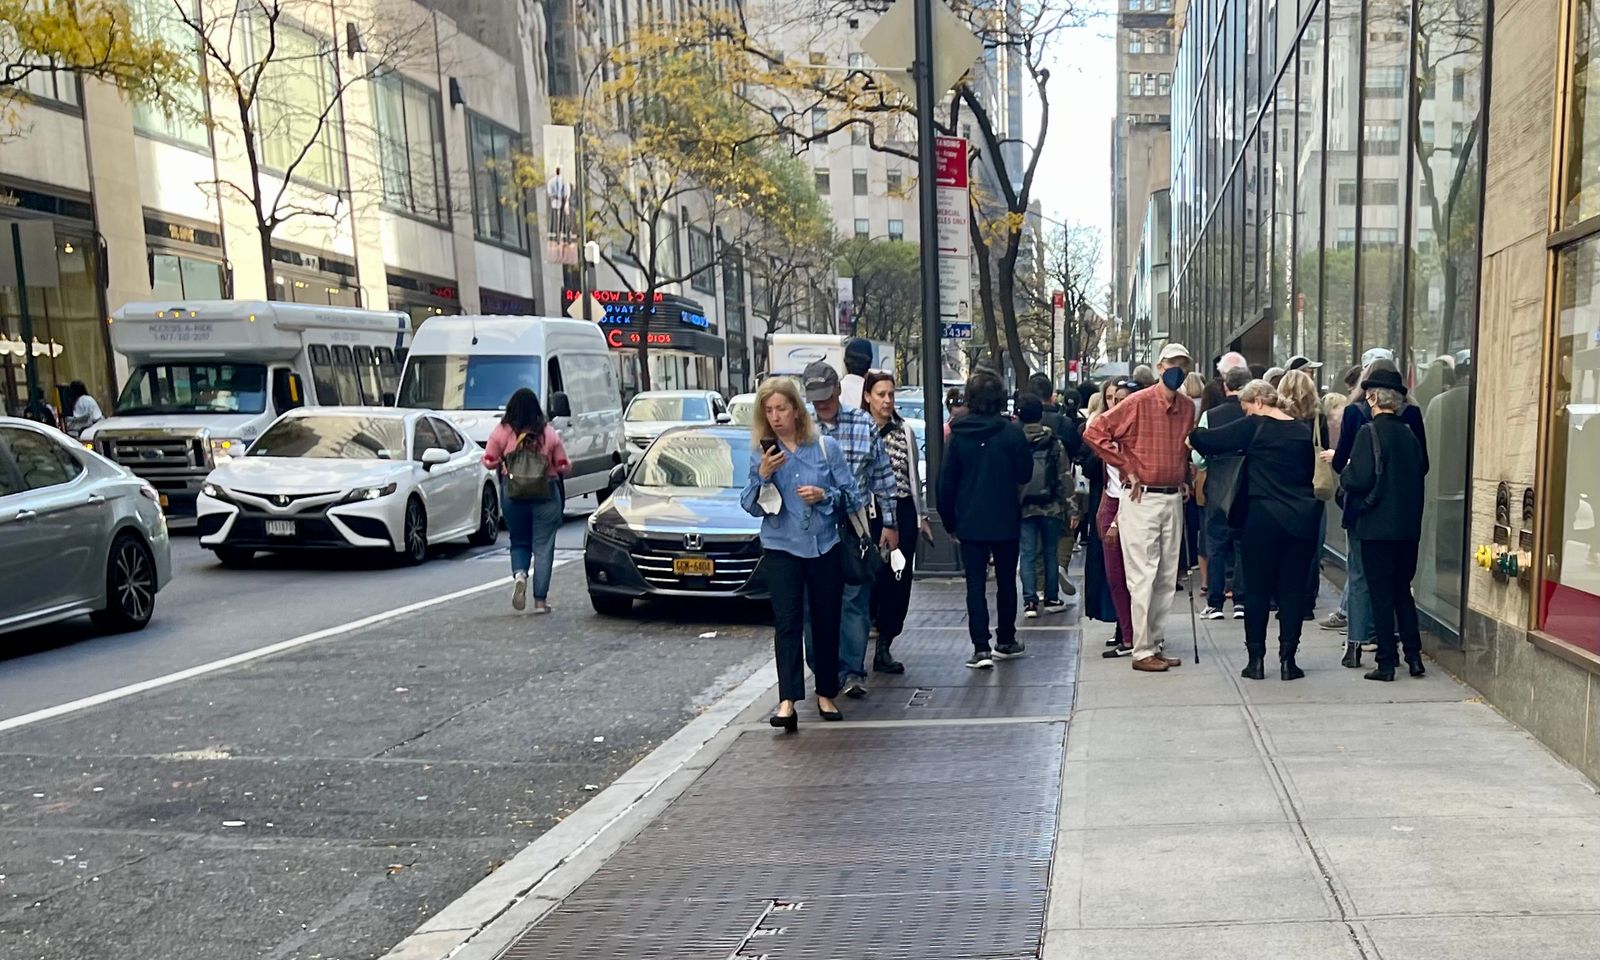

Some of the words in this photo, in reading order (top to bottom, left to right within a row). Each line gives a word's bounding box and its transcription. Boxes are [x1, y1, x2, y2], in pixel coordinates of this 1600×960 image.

[936, 139, 960, 148] TANDING
[937, 208, 960, 217] MERCIAL
[566, 289, 620, 302] RABOW
[628, 291, 663, 303] ROM
[601, 316, 631, 324] DECK
[630, 333, 671, 344] STDIOS
